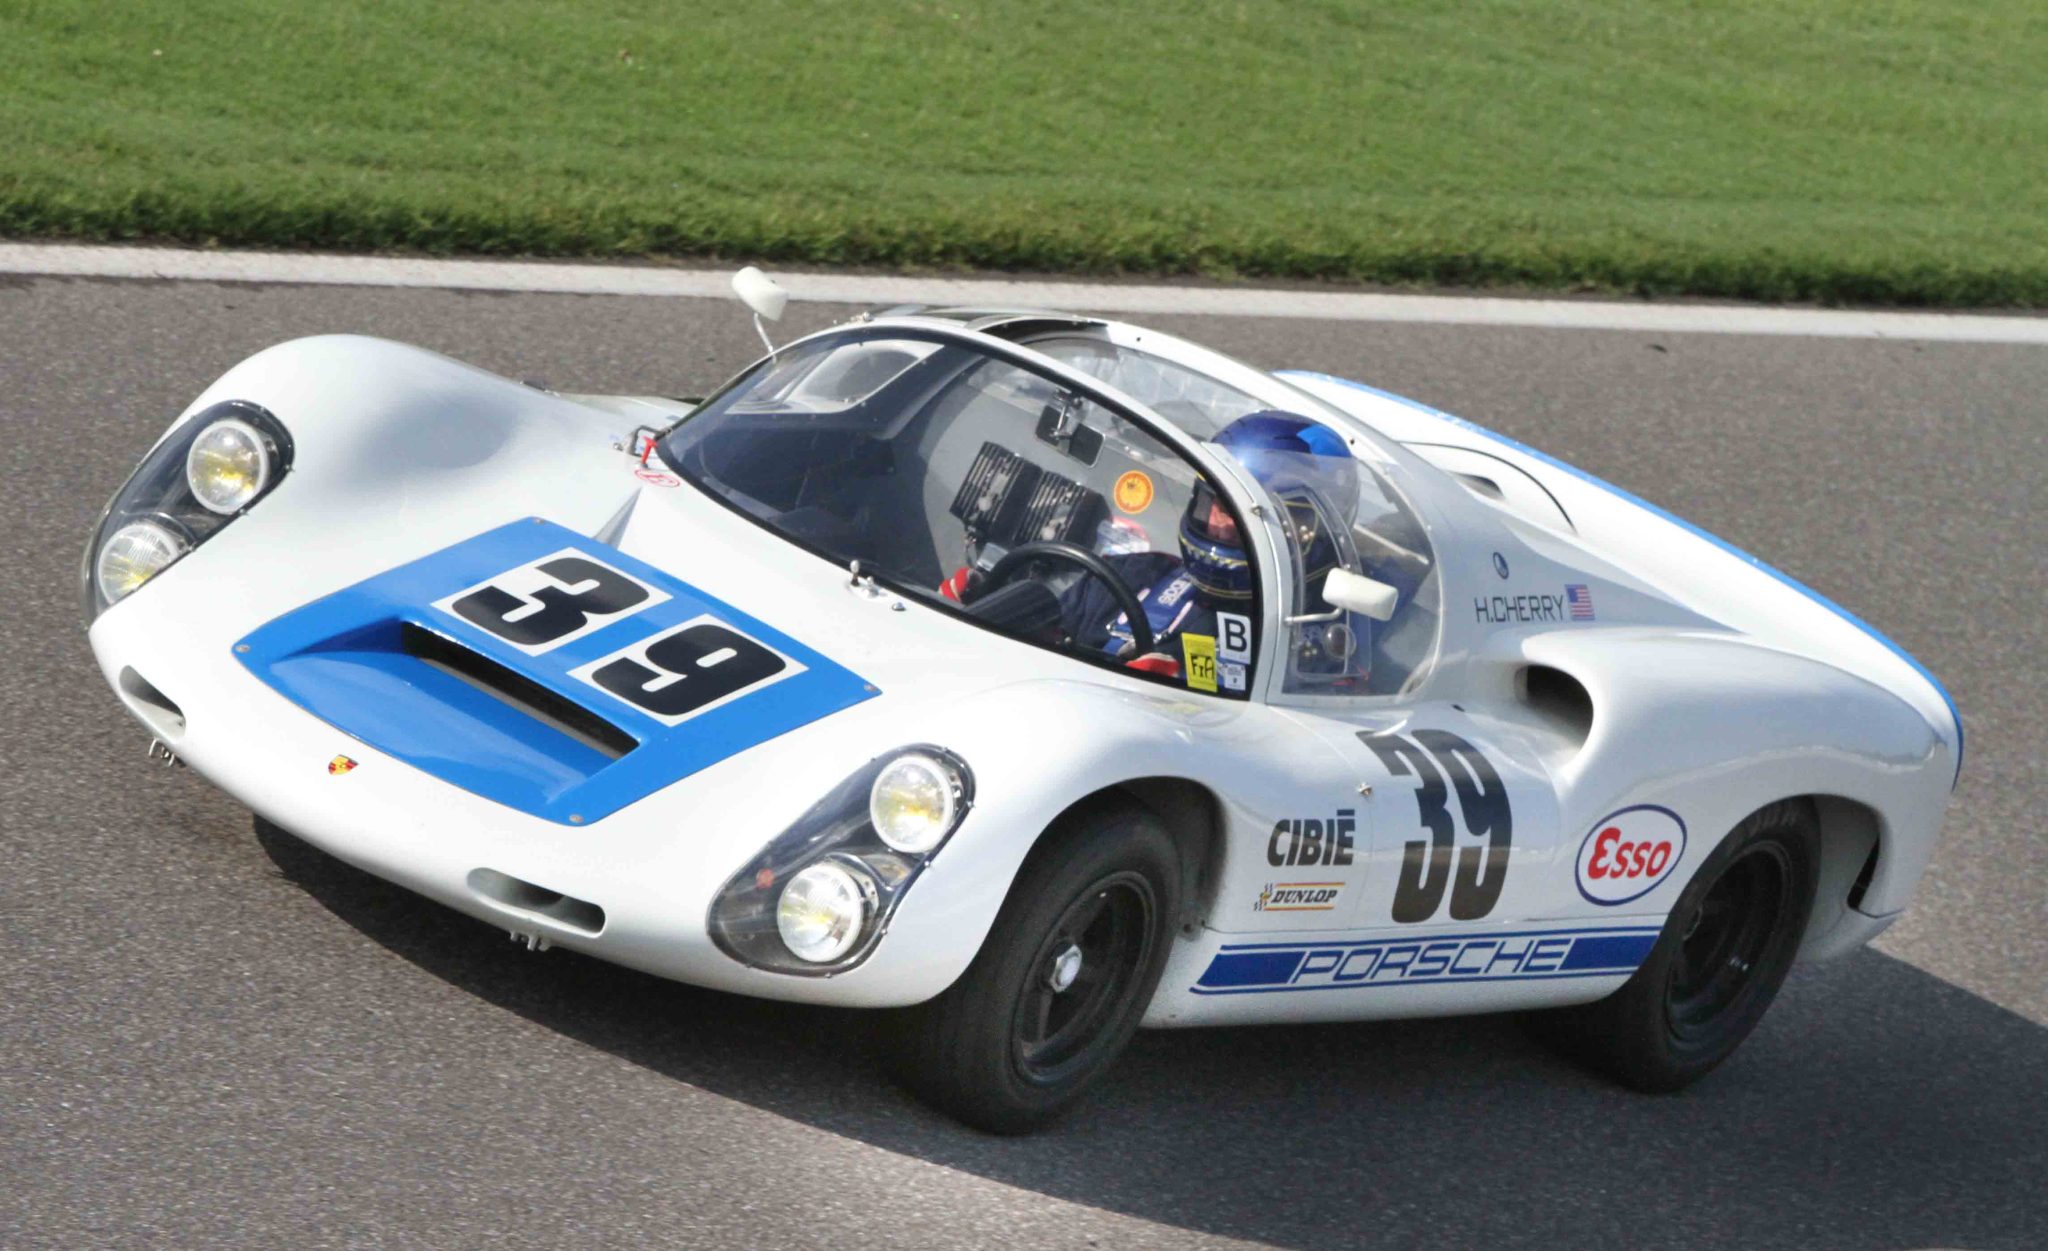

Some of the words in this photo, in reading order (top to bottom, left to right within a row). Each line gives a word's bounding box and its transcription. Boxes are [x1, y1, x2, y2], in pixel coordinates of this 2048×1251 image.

[1474, 594, 1564, 623] H.CHERRY
[452, 557, 786, 716] 39
[1224, 618, 1247, 652] B
[1355, 728, 1512, 923] 39
[1587, 827, 1672, 880] Esso
[1271, 889, 1338, 903] DUNLOP
[1291, 938, 1571, 985] PORSCHE
